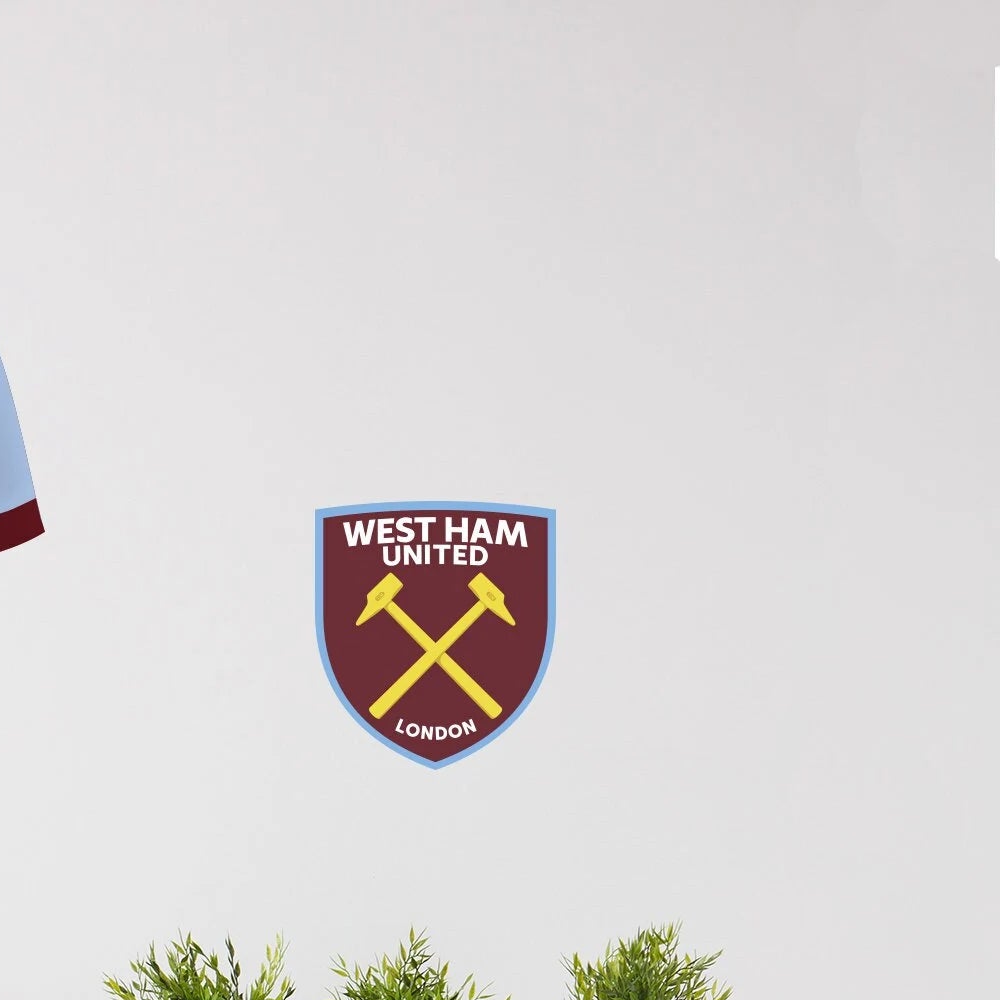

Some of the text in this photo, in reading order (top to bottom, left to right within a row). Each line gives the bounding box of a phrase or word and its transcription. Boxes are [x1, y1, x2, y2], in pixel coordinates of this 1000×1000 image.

[343, 517, 528, 547] WEST HAM
[382, 544, 489, 566] UNITED
[395, 718, 477, 741] LONDON
